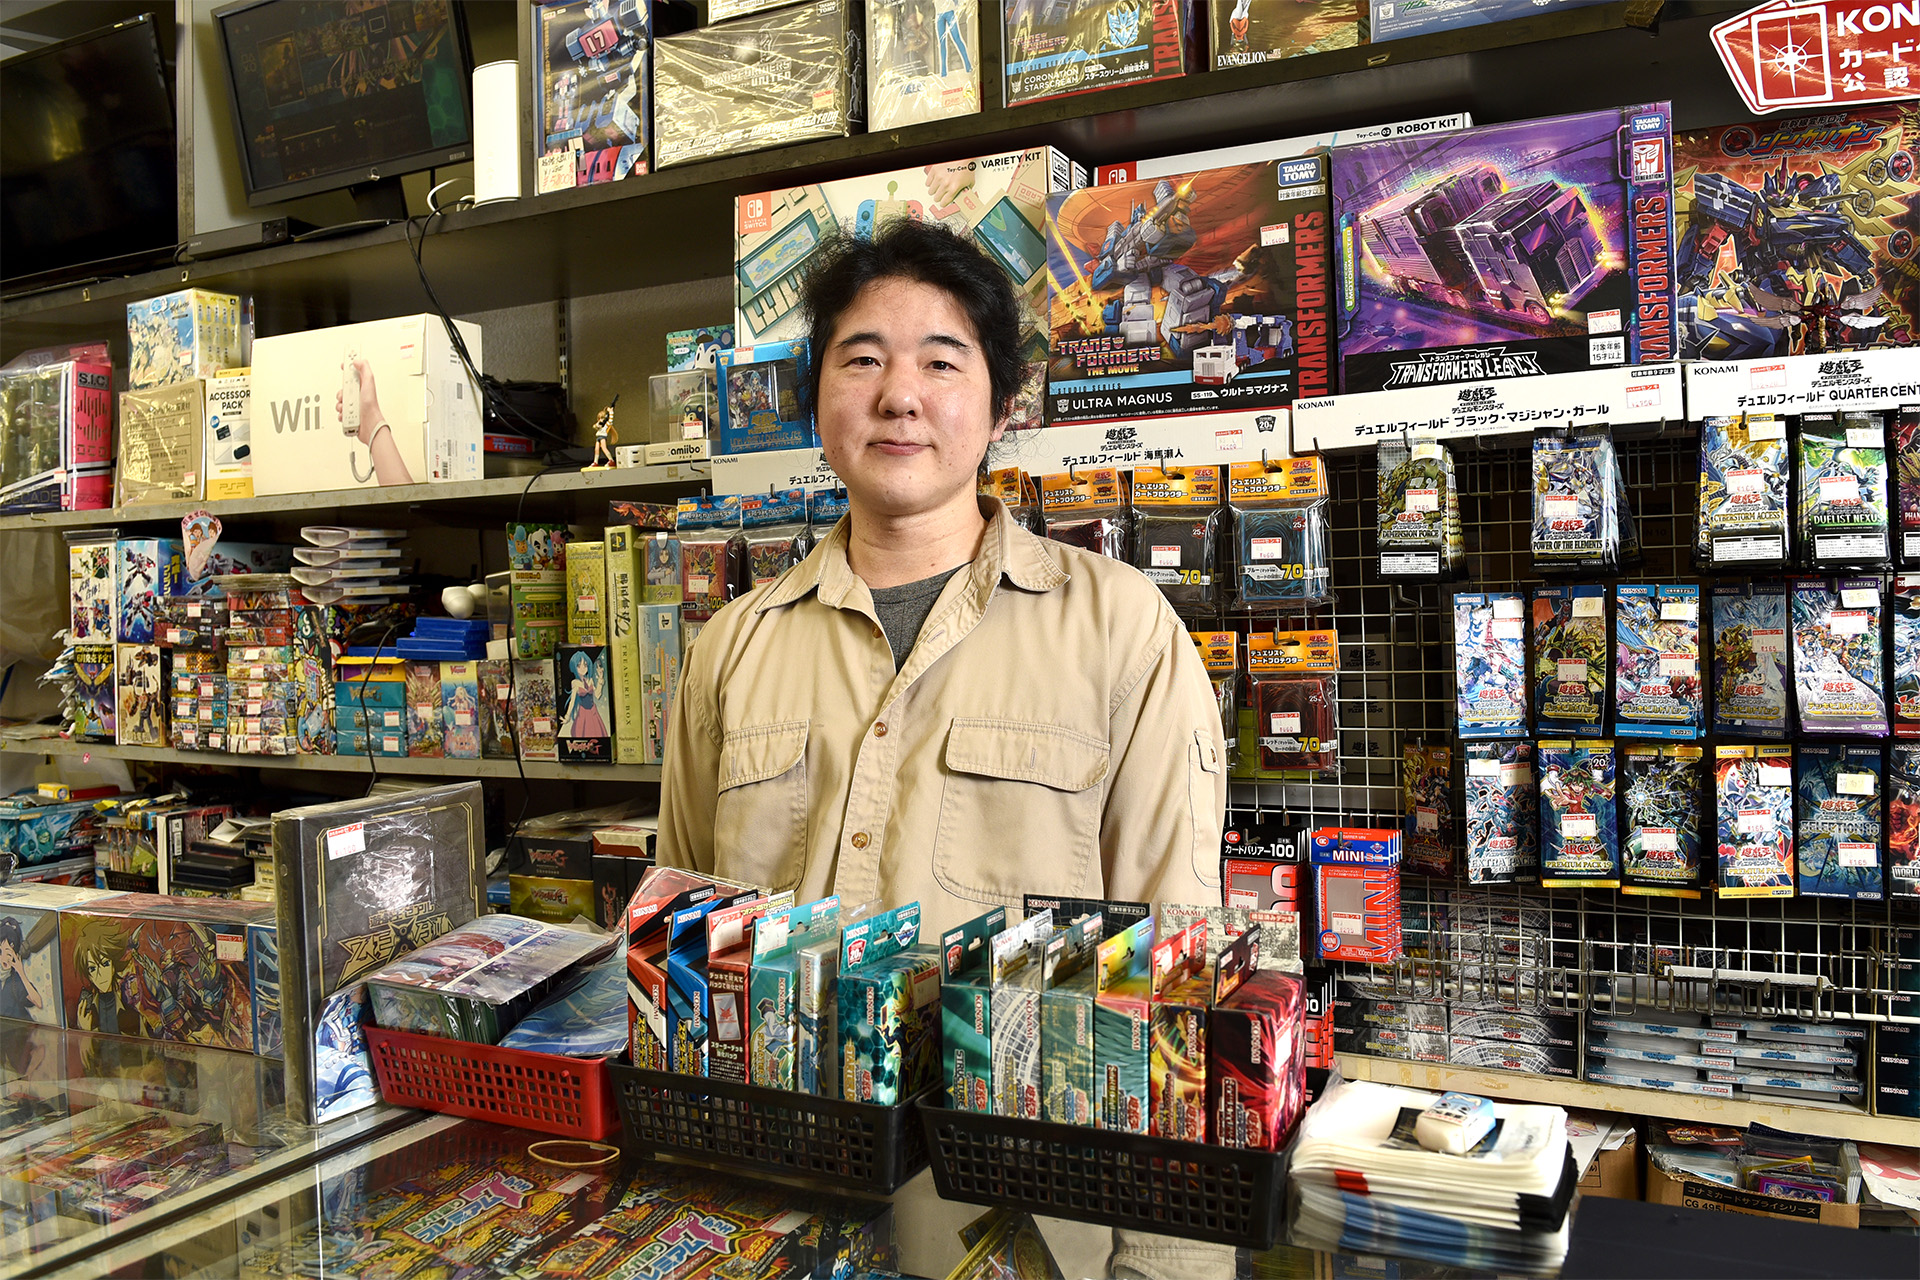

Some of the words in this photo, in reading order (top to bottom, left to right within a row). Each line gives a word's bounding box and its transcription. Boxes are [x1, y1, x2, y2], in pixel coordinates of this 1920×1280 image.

[1836, 0, 1920, 37] KON
[586, 29, 606, 53] 17
[1217, 51, 1267, 67] EVANGELION
[1838, 39, 1920, 70] カード
[1024, 69, 1079, 84] CORONATION
[1024, 76, 1079, 93] STARSCREAM
[1396, 121, 1437, 135] ROBOT
[1438, 117, 1458, 130] KIT
[1635, 116, 1661, 124] TAKARA
[1635, 120, 1661, 131] TOMY
[981, 155, 1023, 169] VARIETY
[1025, 151, 1042, 162] KIT
[1282, 161, 1317, 173] TAKARA
[1282, 170, 1317, 183] TOMY
[1634, 172, 1666, 182] GENERATIONS
[1294, 210, 1325, 399] TRANSFORMERS
[1055, 337, 1111, 356] TRANS
[1076, 346, 1161, 367] FORMERS
[1087, 367, 1104, 376] THE
[1107, 364, 1140, 375] MOVIE
[1392, 360, 1486, 385] TRANSFORMERS
[1486, 354, 1540, 378] LEGACY
[1694, 365, 1739, 376] KONAMI
[1220, 383, 1289, 397] ウルトラマグナス
[1072, 397, 1112, 410] ULTRA
[1117, 392, 1173, 407] MAGNUS
[1737, 391, 1825, 408] デュエルフィールド
[1829, 386, 1889, 402] QUARTER
[222, 401, 244, 410] PACK
[1297, 400, 1335, 411] KONAMI
[270, 394, 321, 434] Wii
[1354, 417, 1450, 437] デュエルフィールド
[1454, 404, 1610, 428] ブラック・マジシャン・ガール
[670, 445, 701, 456] amiibo
[1062, 450, 1141, 467] デュエルフィールド
[1231, 478, 1268, 486] デュエリスト
[1044, 489, 1074, 498] デュエリスト
[1134, 490, 1188, 498] カードプロテクター
[1231, 485, 1287, 494] カードプロテクター
[1044, 495, 1091, 505] カードプロテクター
[1713, 512, 1756, 522] CYBERSTORM
[1756, 511, 1781, 521] ACCESS
[1813, 514, 1851, 524] DUELIST
[1853, 513, 1883, 523] NEXUS
[1382, 529, 1417, 538] DIMENSION
[1418, 529, 1440, 538] FORCE
[1533, 541, 1552, 550] POWER
[1552, 541, 1561, 550] OF
[1561, 541, 1573, 549] THE
[1574, 540, 1603, 549] ELEMENTS
[1179, 570, 1201, 585] 70
[1281, 563, 1304, 579] 70
[1250, 656, 1304, 664] カードプロテクター
[1622, 704, 1689, 715] デッキビルドパック
[1719, 705, 1780, 714] デッキビルドパック
[1807, 702, 1877, 711] デッキビルドパック
[1298, 737, 1320, 752] 70
[1800, 821, 1864, 834] SELECTION
[1225, 843, 1295, 858] カードバリアー100
[1332, 849, 1365, 863] MINI
[1470, 856, 1506, 867] EXTRA
[1507, 855, 1537, 866] PACK
[1546, 861, 1578, 869] PREMIUM
[1578, 860, 1597, 868] PACK
[1627, 868, 1659, 876] PREMIUM
[1660, 870, 1682, 878] PACK
[1727, 867, 1764, 875] PREMIUM
[1765, 866, 1786, 874] PACK
[1748, 874, 1767, 882] 2020
[632, 904, 658, 917] KONAMI
[1028, 899, 1060, 909] KONAMI
[677, 910, 702, 924] KONAMI
[1166, 907, 1201, 917] KONAMI
[778, 978, 786, 1016] KONAMI
[866, 987, 874, 1025] KONAMI
[975, 995, 983, 1034] KONAMI
[1077, 1004, 1086, 1046] KONAMI
[1132, 1009, 1141, 1051] KONAMI
[1187, 1014, 1197, 1058] KONAMI
[1251, 1019, 1261, 1064] KONAMI
[1685, 1198, 1699, 1209] CG
[1686, 1184, 1817, 1216] コナミカードサプライシリーズ
